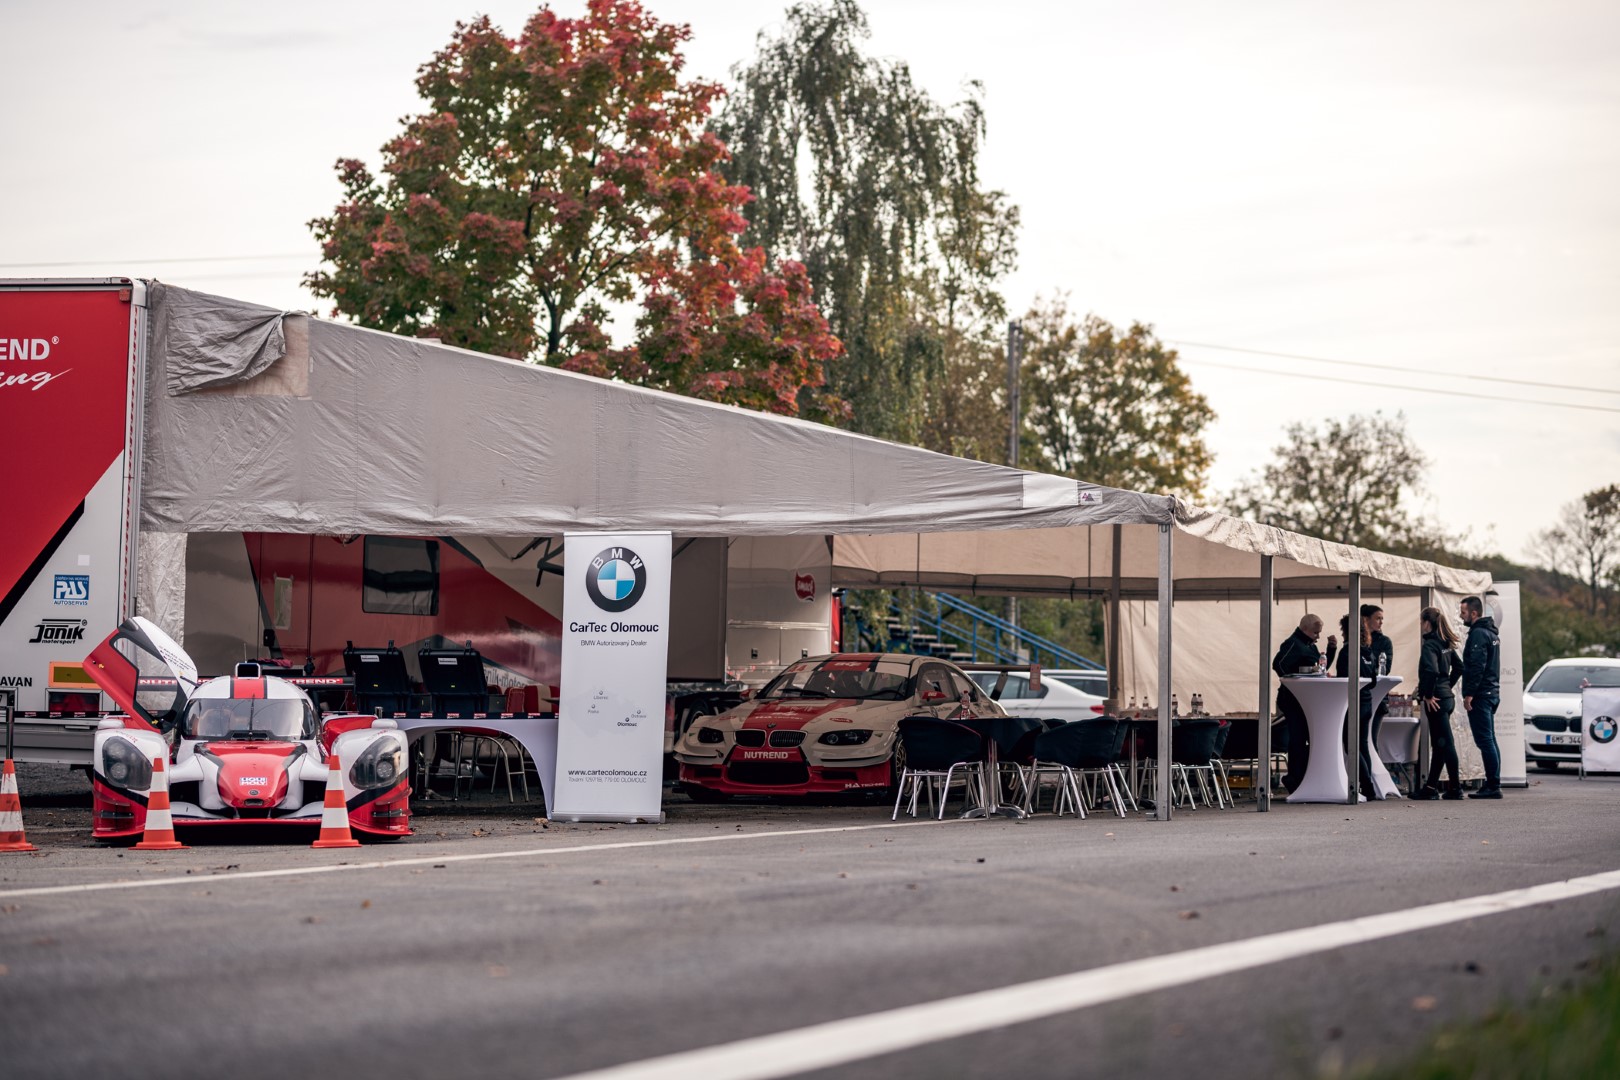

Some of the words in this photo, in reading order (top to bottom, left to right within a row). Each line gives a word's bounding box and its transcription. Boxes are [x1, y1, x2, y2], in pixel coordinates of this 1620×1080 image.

[591, 548, 643, 570] BMW
[569, 621, 607, 633] CarTec
[610, 621, 659, 633] Olomouc
[0, 676, 33, 687] AVAN
[744, 751, 788, 759] NUTREND
[567, 769, 648, 777] www.cartecolomouc.cz
